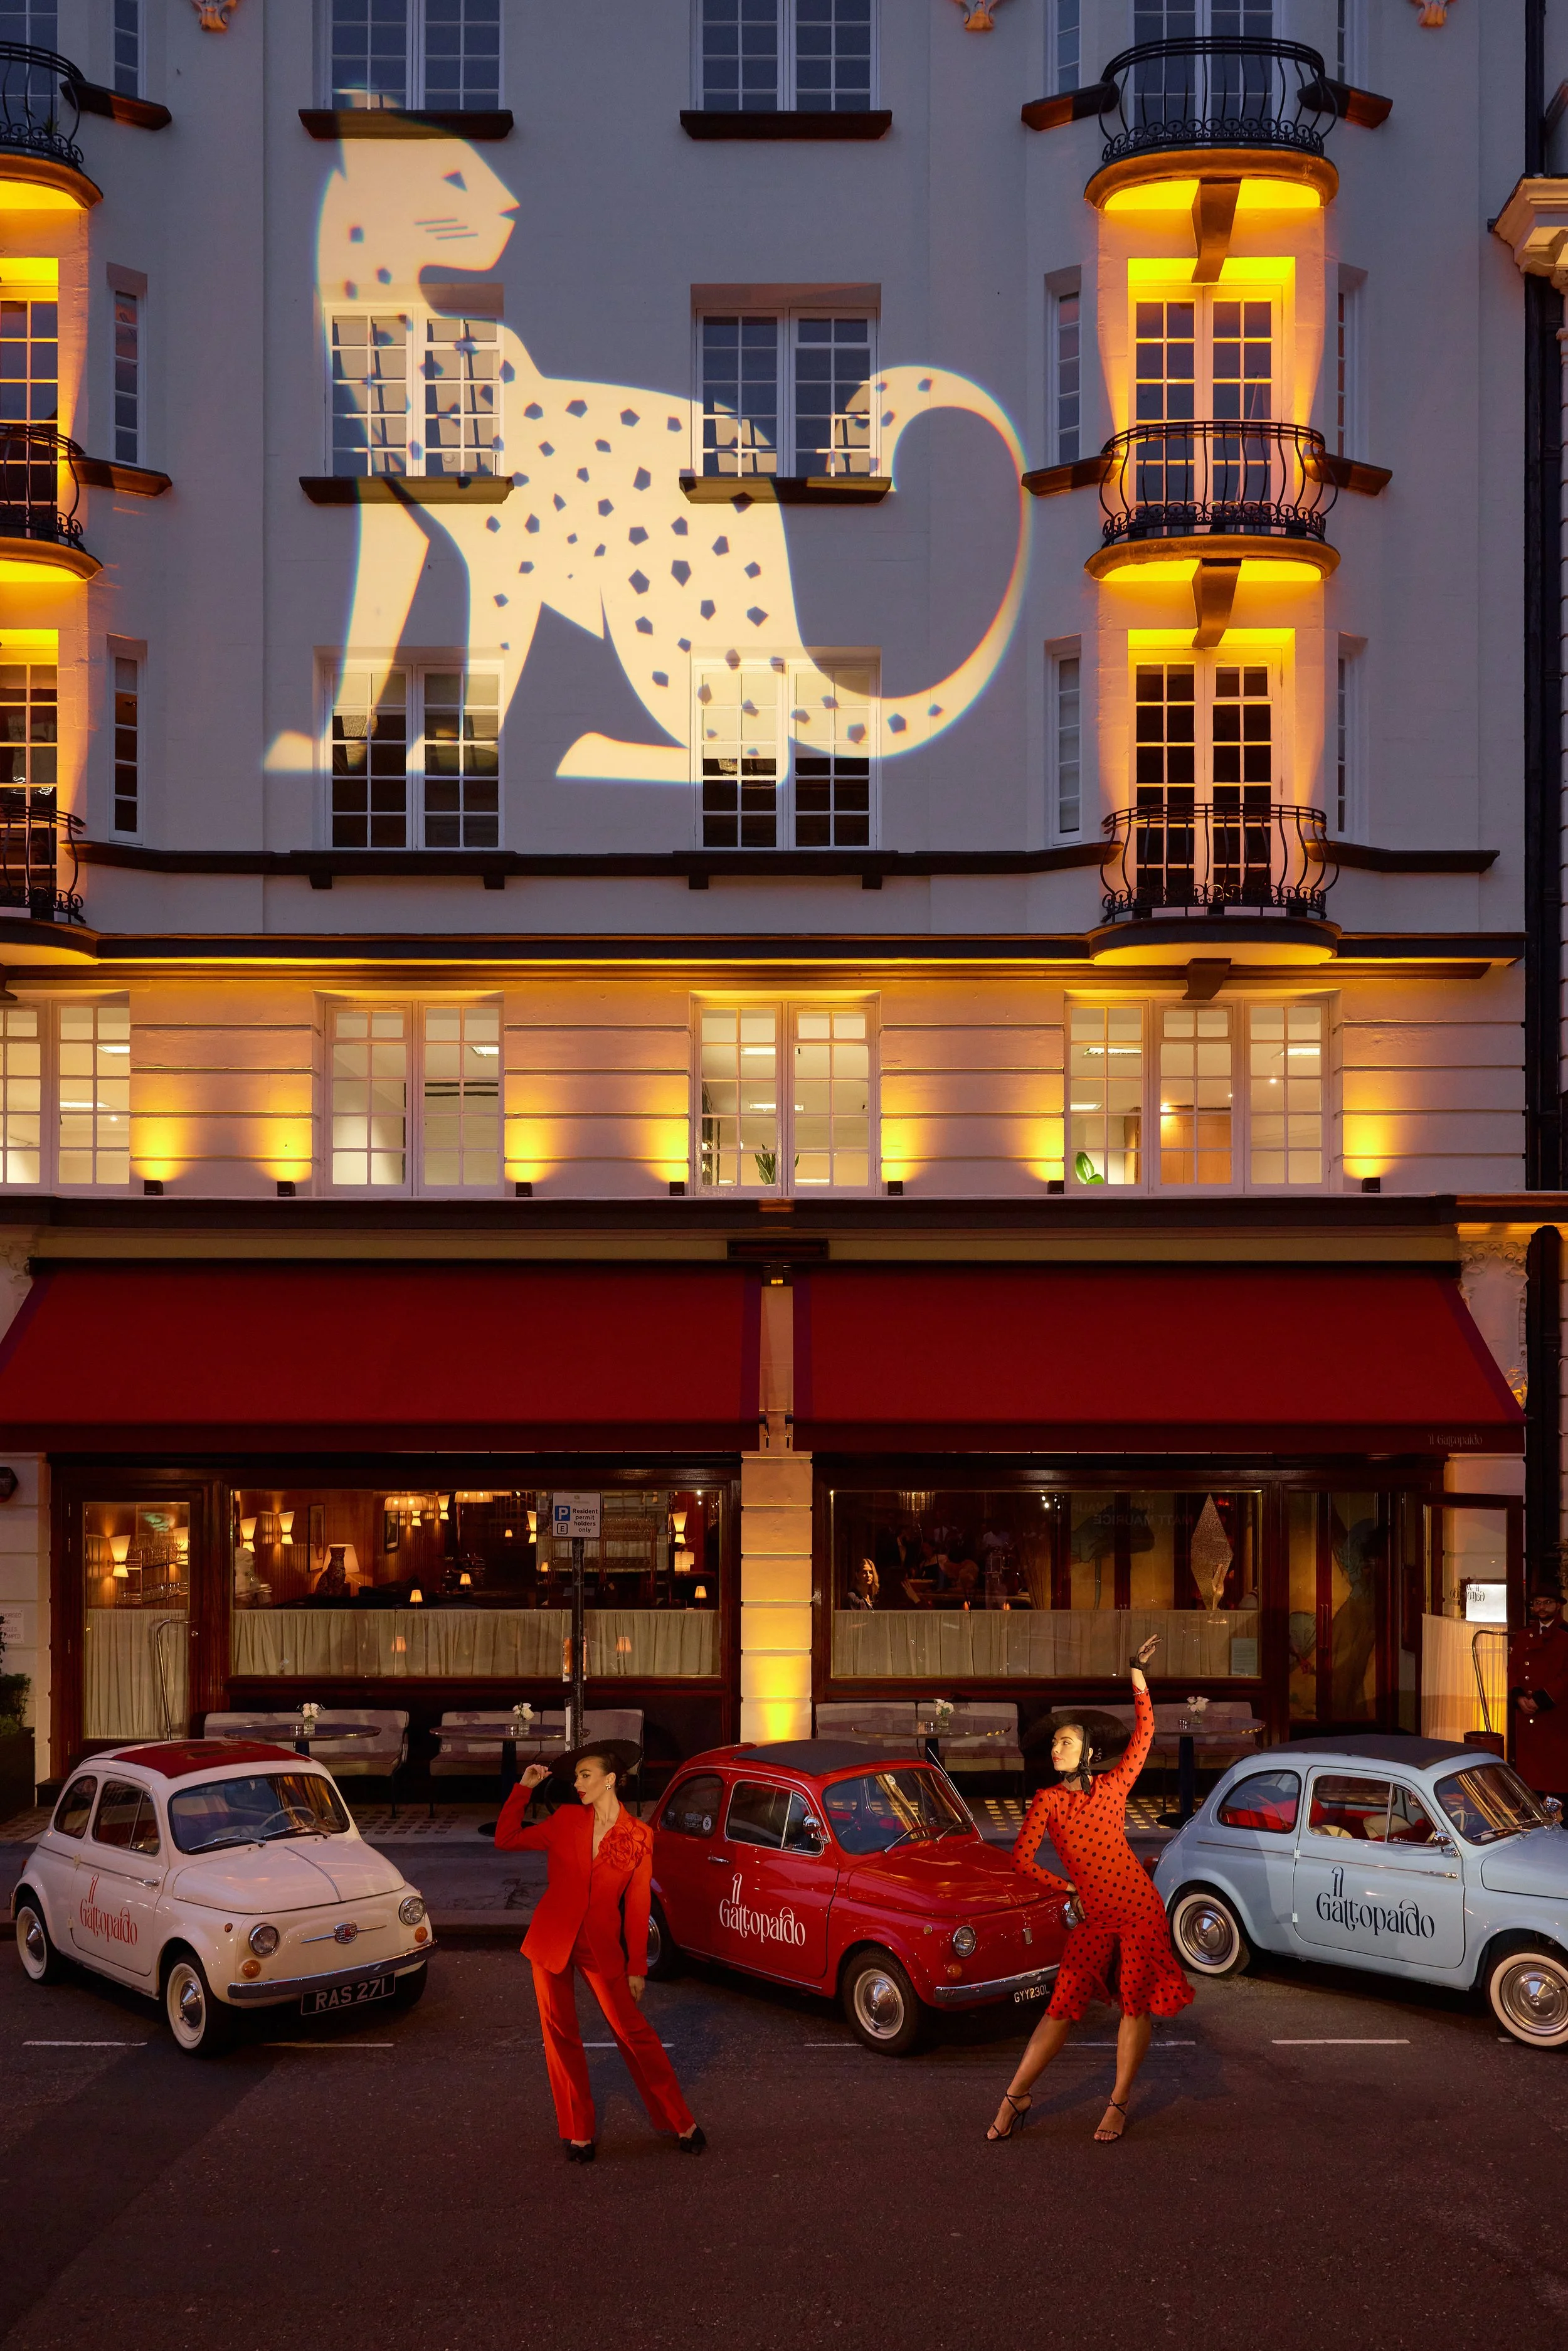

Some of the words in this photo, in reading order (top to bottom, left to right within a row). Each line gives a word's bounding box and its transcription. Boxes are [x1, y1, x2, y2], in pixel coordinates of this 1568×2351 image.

[1437, 1433, 1483, 1447] Gattopardo
[80, 1897, 137, 1946] Gattopardo
[719, 1899, 806, 1946] Gattopardo
[1316, 1892, 1435, 1939] Gattopardo
[315, 1985, 352, 2011] RAS
[356, 1978, 385, 2000] 271
